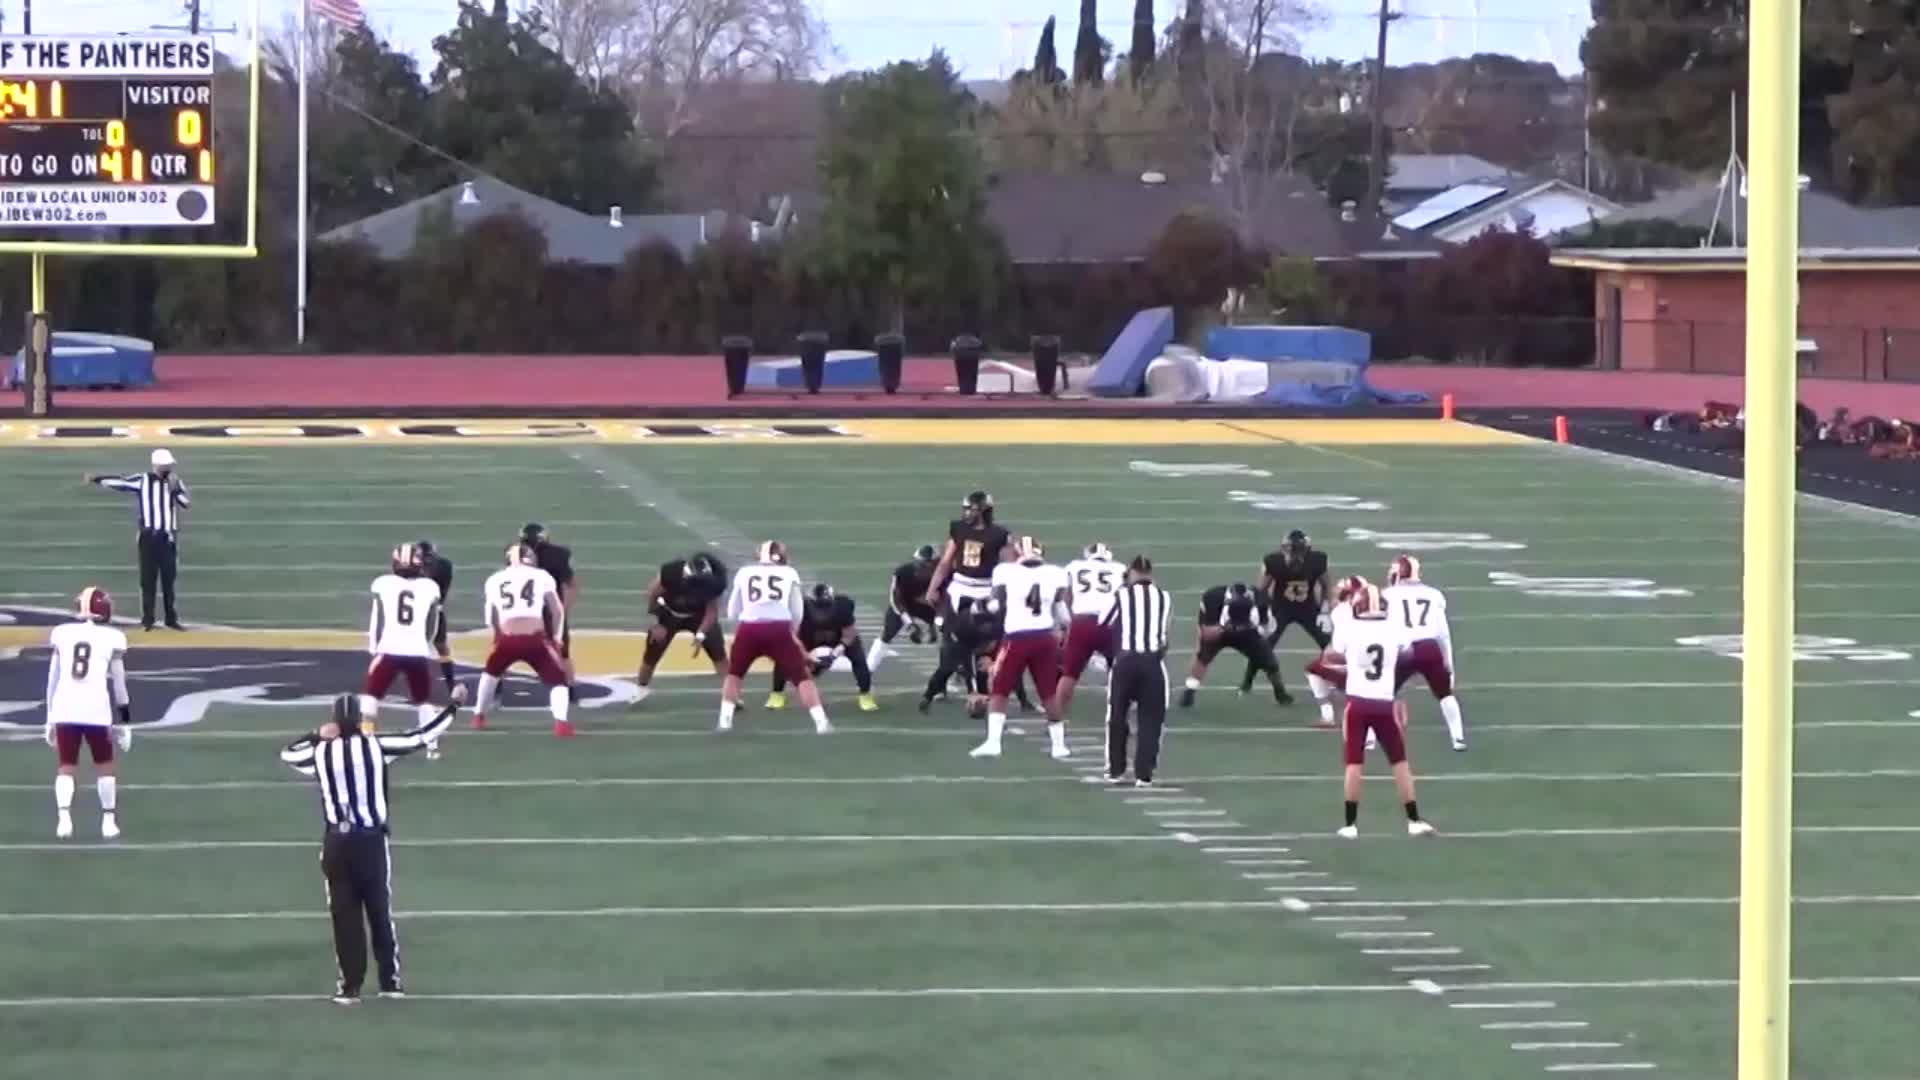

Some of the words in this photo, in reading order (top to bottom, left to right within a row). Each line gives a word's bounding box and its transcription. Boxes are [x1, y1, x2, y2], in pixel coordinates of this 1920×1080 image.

[22, 42, 70, 68] THE
[80, 42, 211, 68] PANTHERS
[128, 86, 210, 104] VISITOR
[106, 120, 125, 147] 0
[178, 110, 201, 145] 0
[0, 154, 23, 176] TO
[32, 154, 58, 175] GO
[71, 154, 97, 176] ON
[100, 150, 143, 182] 41
[151, 154, 187, 176] QTR
[199, 149, 211, 182] 1
[41, 191, 87, 204] LOCAL
[91, 190, 137, 203] UNION
[140, 191, 168, 203] 302
[500, 579, 534, 611] 54
[748, 575, 783, 602] 65
[1077, 569, 1113, 594] 55
[397, 590, 415, 626] 6
[1025, 582, 1041, 617] 4
[1402, 598, 1430, 628] 17
[71, 641, 92, 681] 8
[1365, 643, 1384, 681] 3
